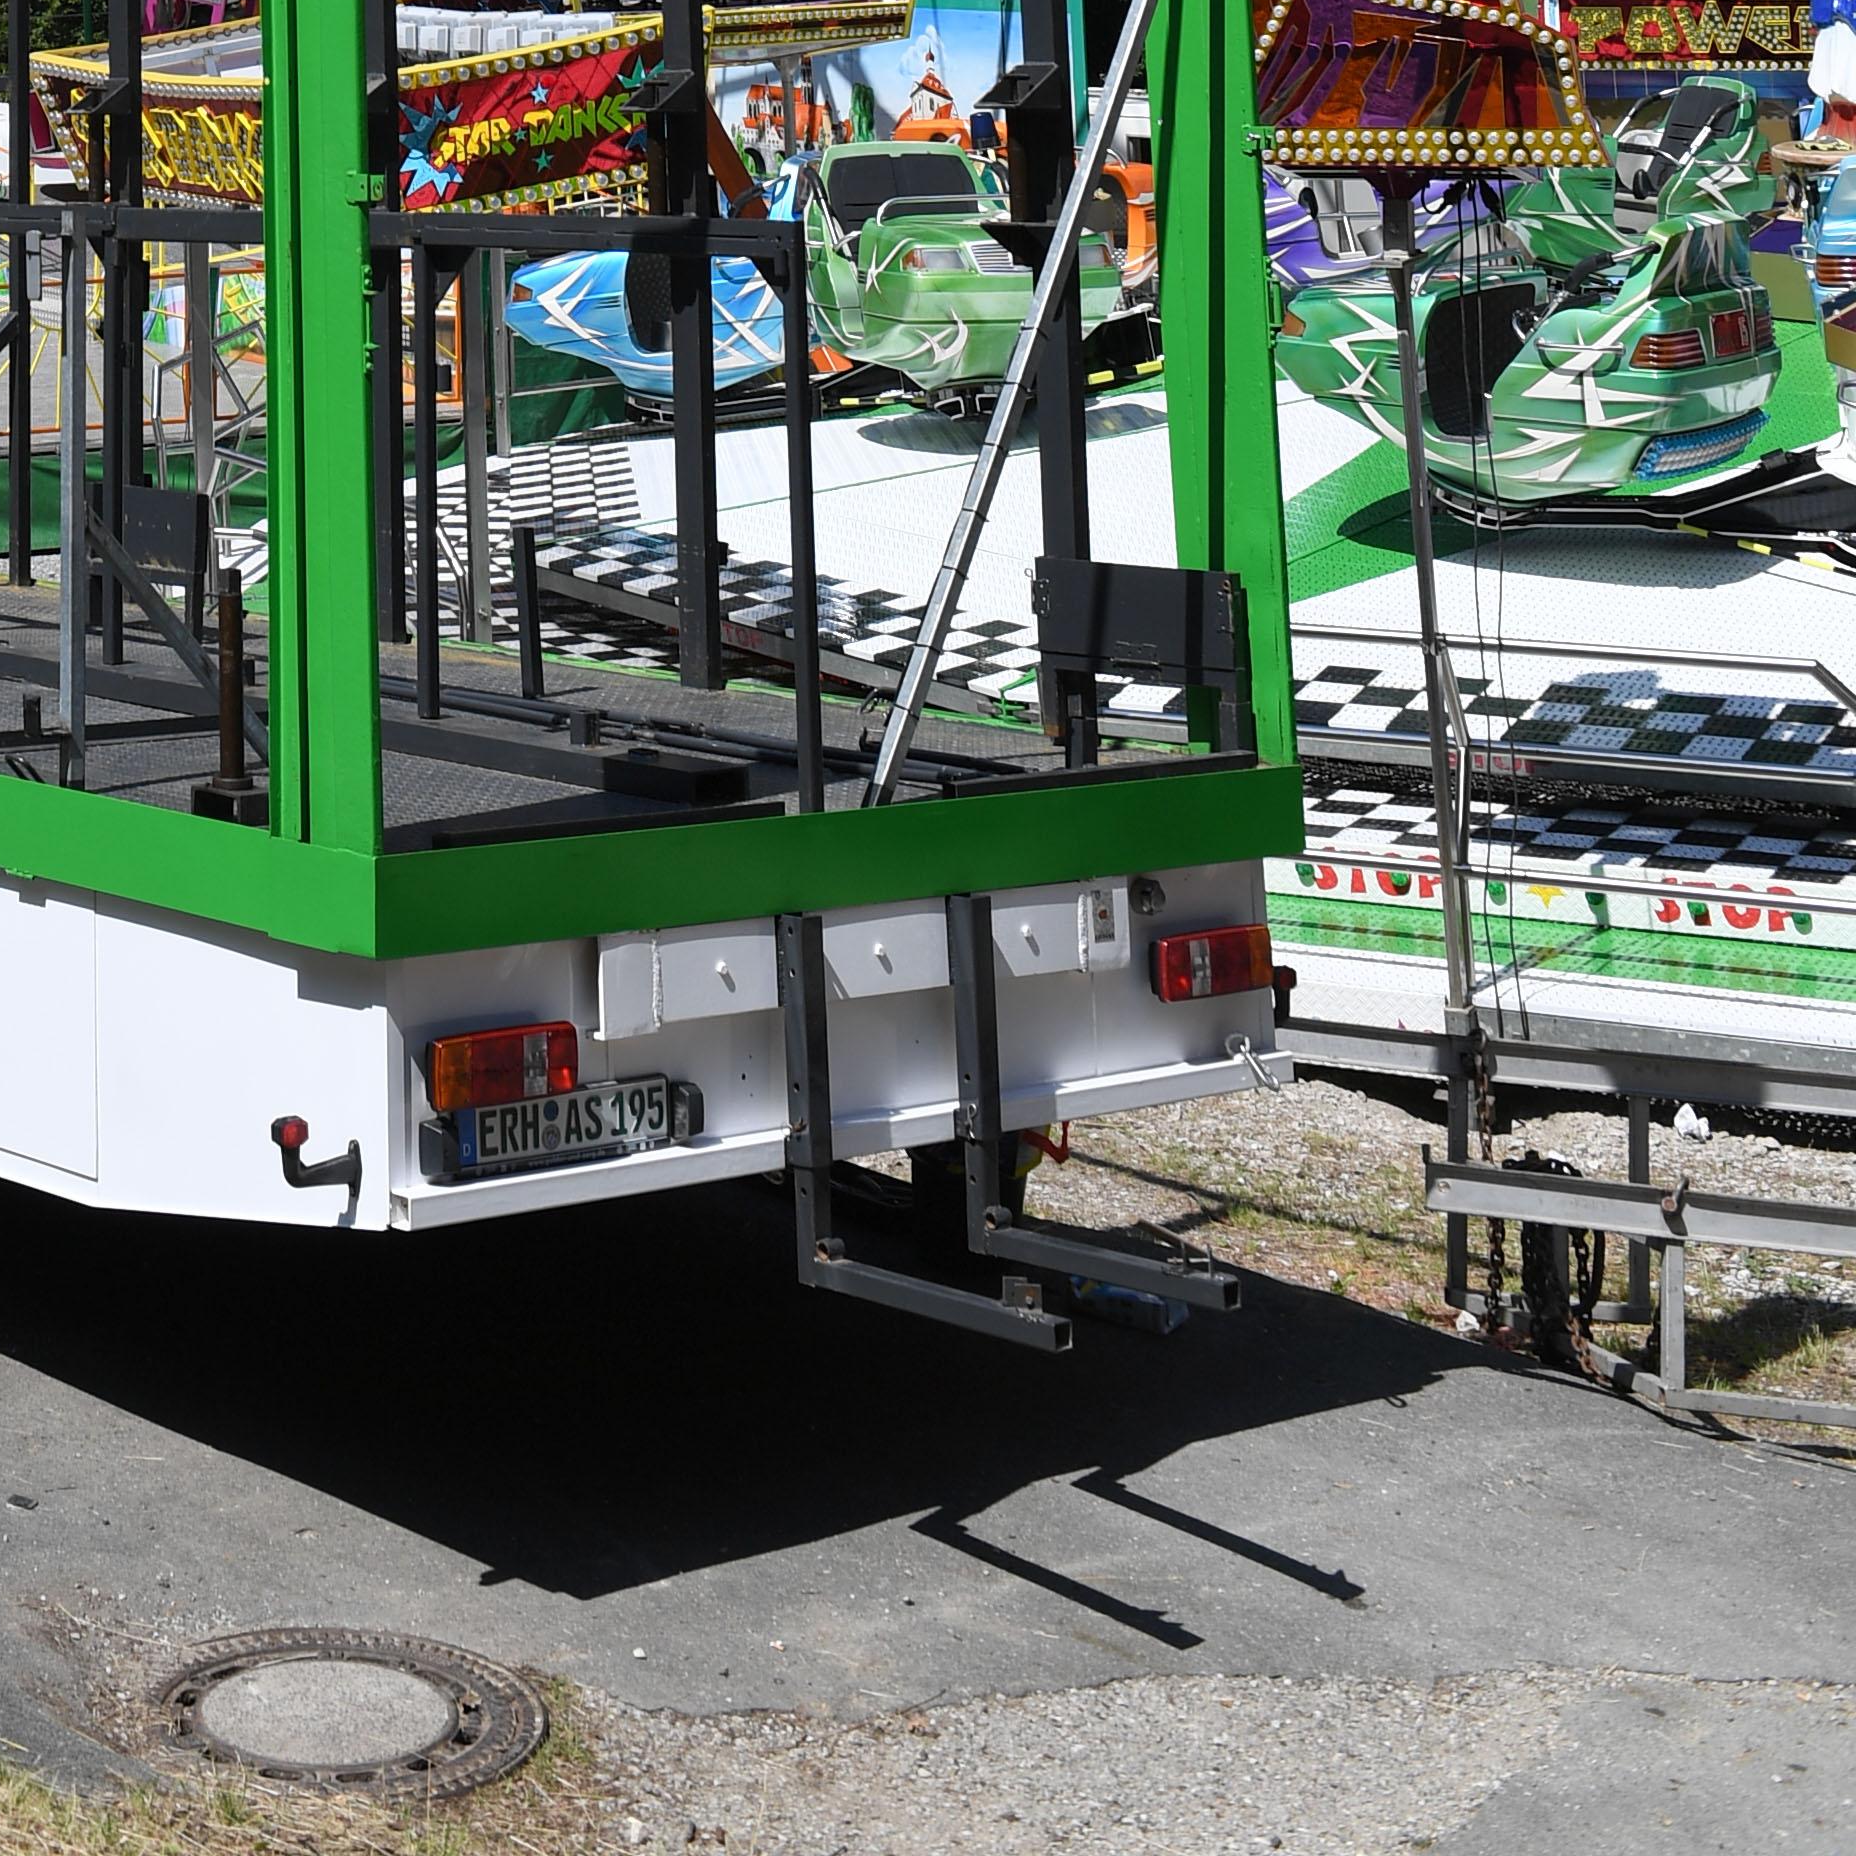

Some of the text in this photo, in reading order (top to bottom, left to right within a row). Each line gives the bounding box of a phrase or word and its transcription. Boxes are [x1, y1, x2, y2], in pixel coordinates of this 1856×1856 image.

[431, 117, 517, 169] STAR
[479, 1086, 664, 1158] ERH AS 195
